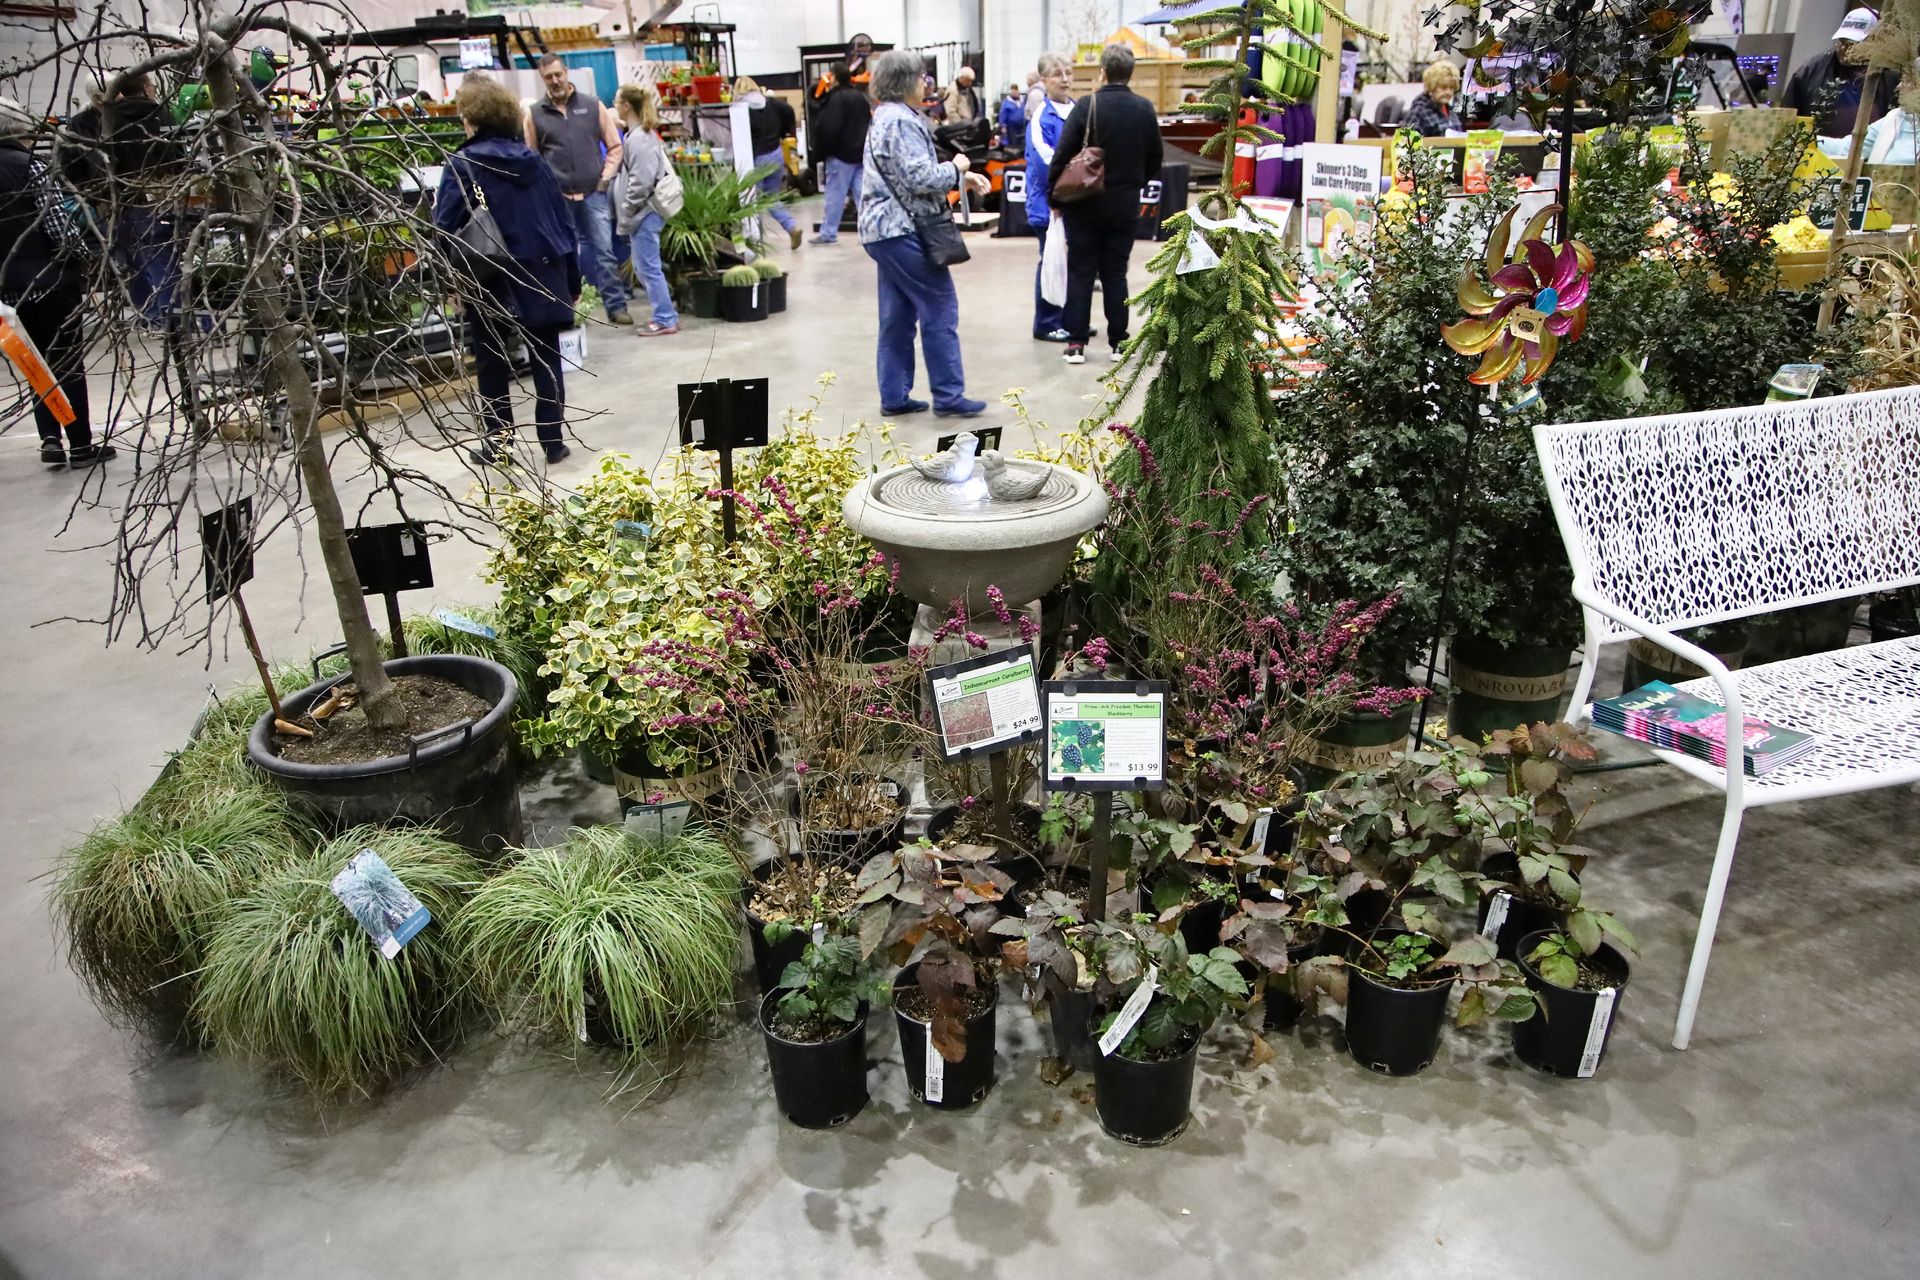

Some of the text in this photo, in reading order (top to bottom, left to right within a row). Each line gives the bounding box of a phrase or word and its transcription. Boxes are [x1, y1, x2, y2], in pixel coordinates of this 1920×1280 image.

[1316, 162, 1368, 180] Skinner's 3 Step
[1311, 174, 1373, 193] Lawn Care Program
[1001, 668, 1030, 681] Coralberry
[1012, 715, 1039, 730] $24.99
[1127, 763, 1159, 773] $13.99
